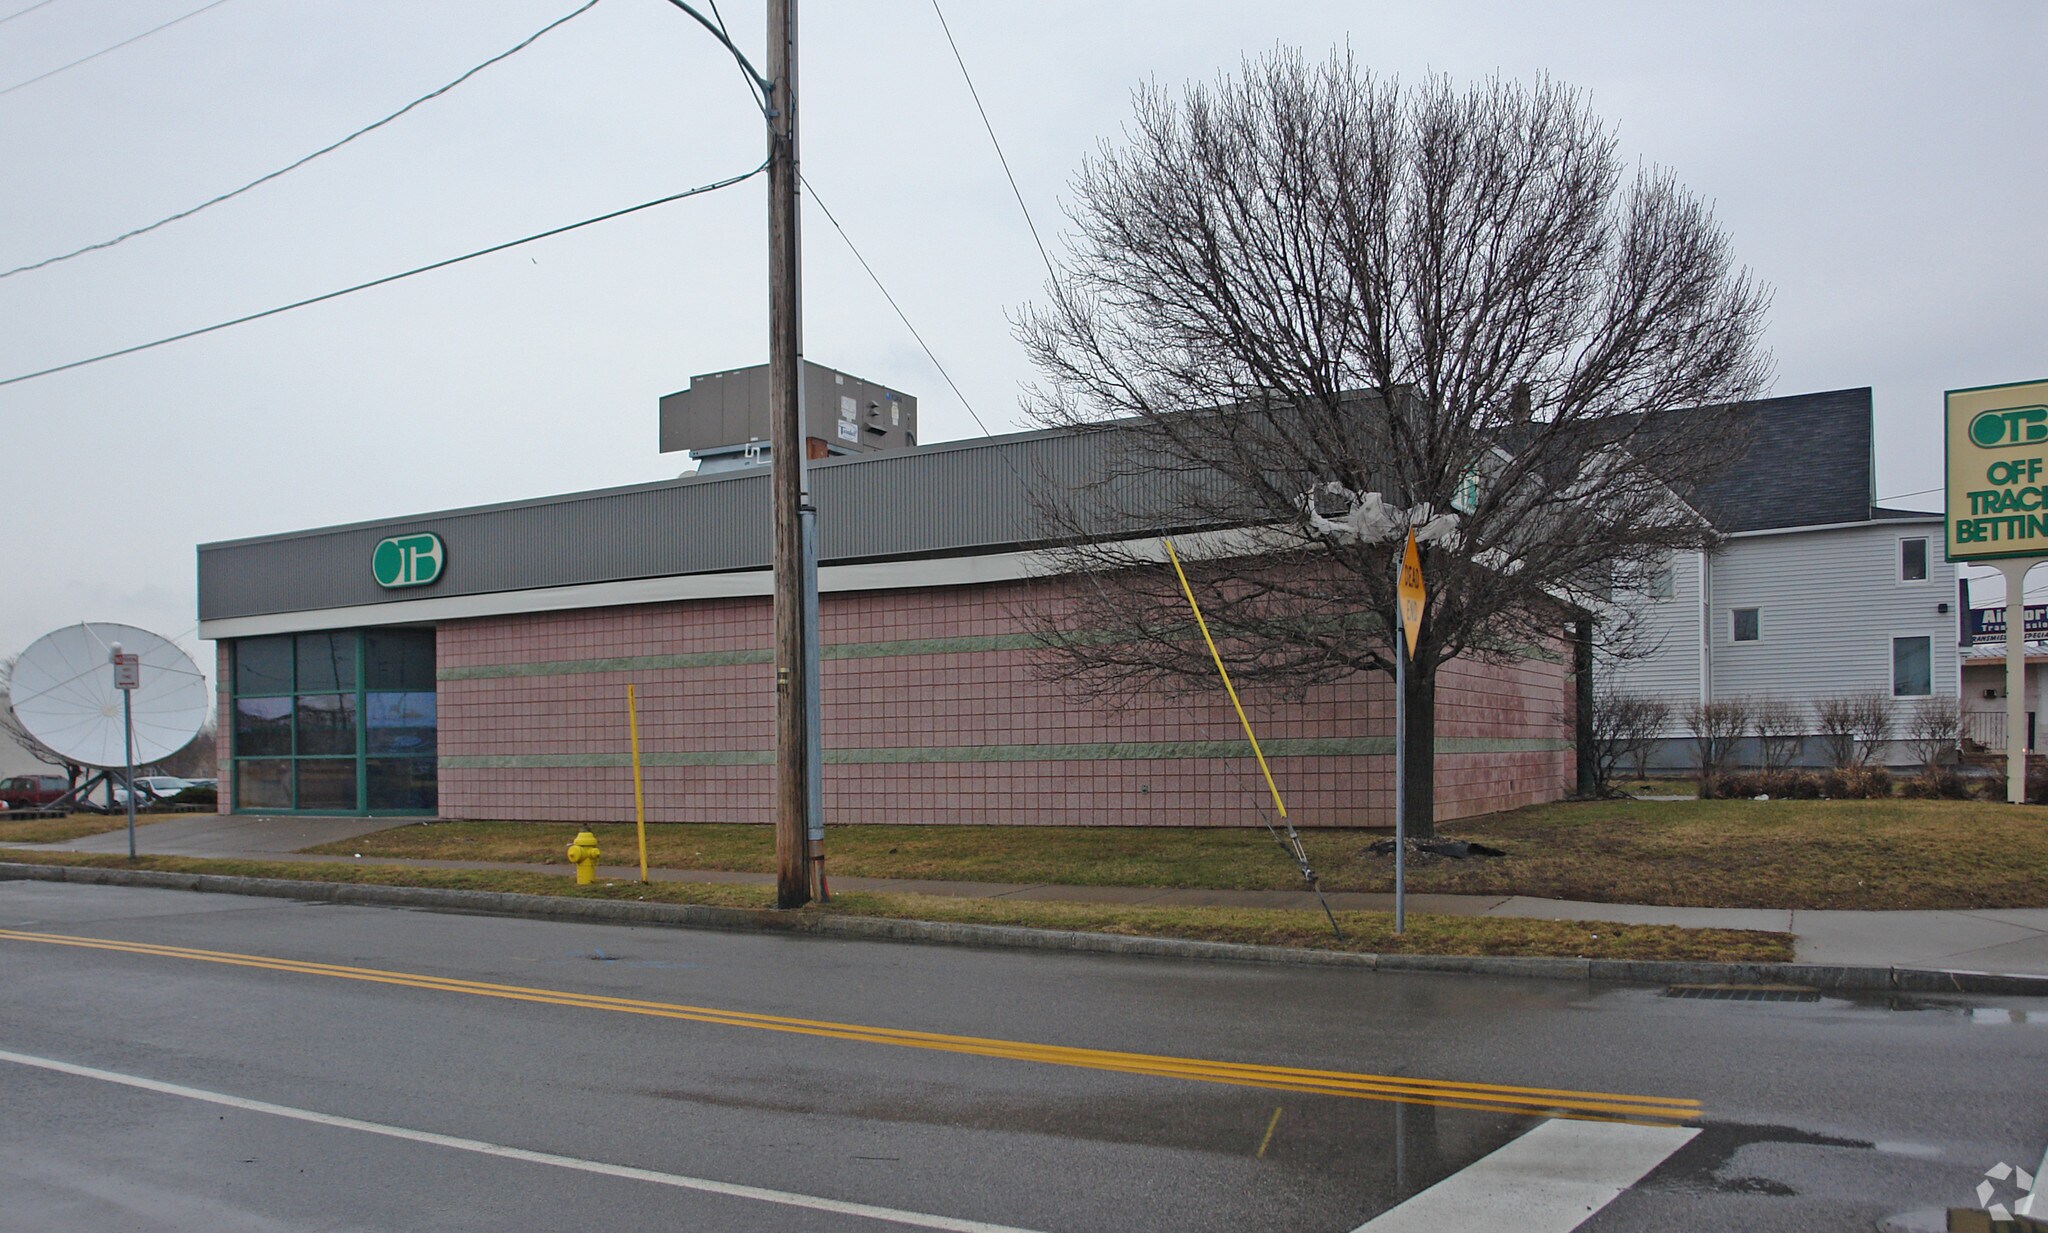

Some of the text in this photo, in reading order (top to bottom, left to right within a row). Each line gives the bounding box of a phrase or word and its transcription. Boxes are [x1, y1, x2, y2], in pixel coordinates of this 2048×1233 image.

[1973, 408, 2048, 446] OTB
[1987, 458, 2043, 486] OFF
[374, 534, 438, 585] OTB
[1405, 564, 1419, 589] DEAD
[1407, 600, 1417, 621] END
